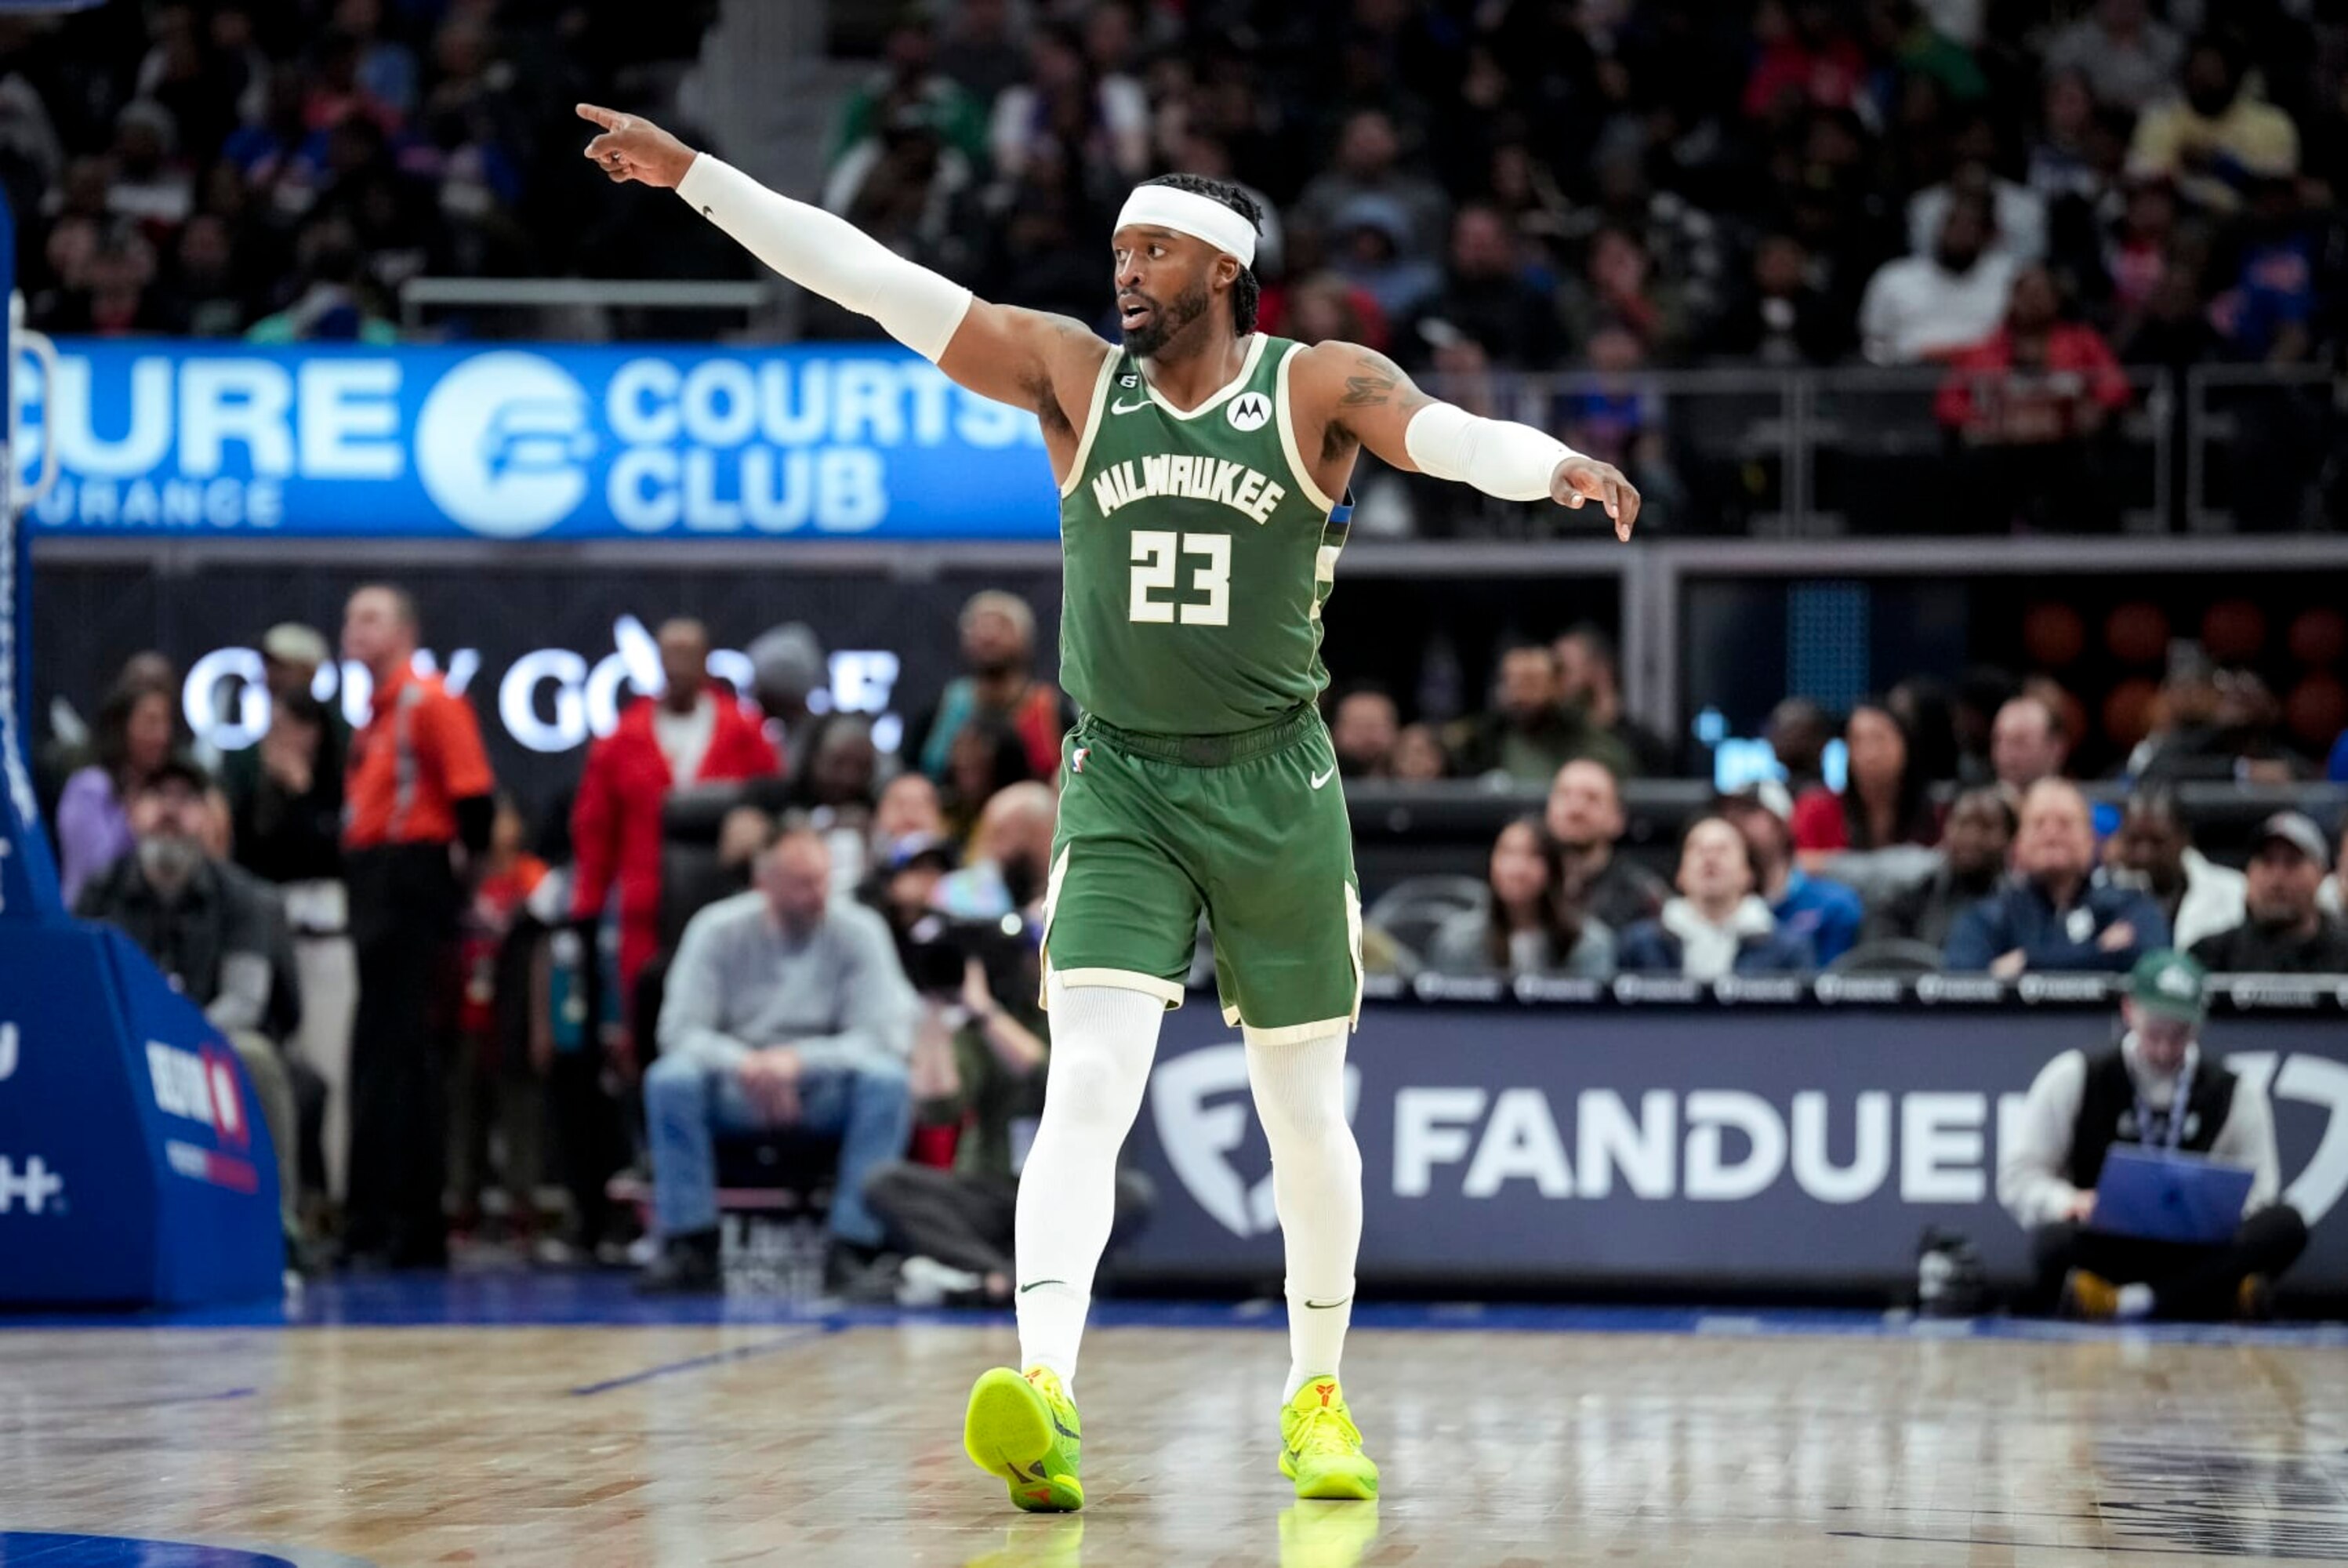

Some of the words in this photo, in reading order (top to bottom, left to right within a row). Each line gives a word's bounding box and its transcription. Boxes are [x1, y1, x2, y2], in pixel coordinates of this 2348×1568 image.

[1120, 376, 1137, 388] 6
[608, 448, 887, 532] CLUB
[1093, 454, 1286, 524] MILWAUKEE
[1129, 531, 1232, 626] 23
